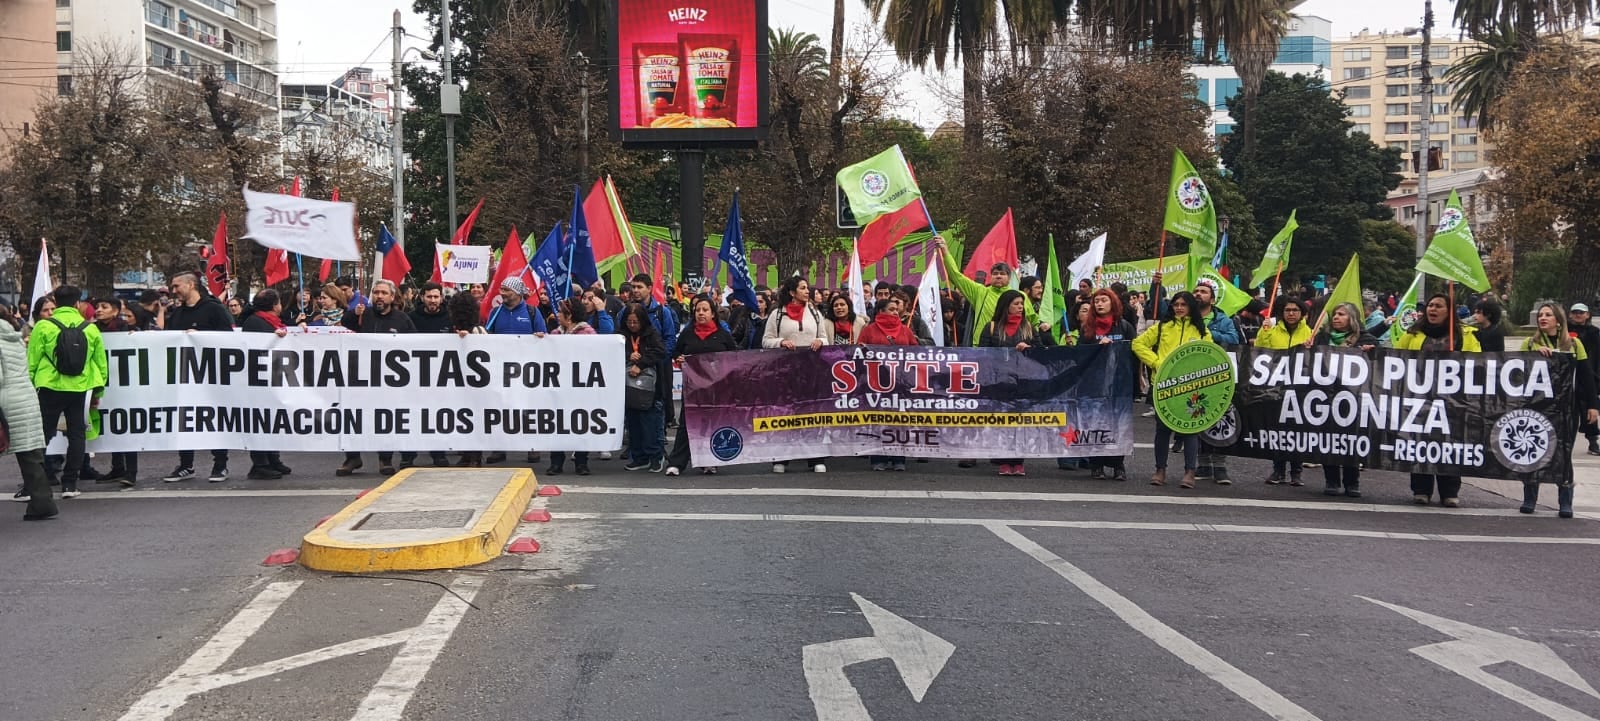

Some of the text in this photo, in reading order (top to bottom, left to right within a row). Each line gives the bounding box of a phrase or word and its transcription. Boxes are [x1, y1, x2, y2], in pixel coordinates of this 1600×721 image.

[667, 7, 708, 22] HEINZ
[650, 57, 674, 66] HEINZ
[699, 51, 725, 59] HEINZ
[453, 260, 479, 270] AJUNJI
[852, 347, 959, 362] Asociación
[1171, 346, 1213, 365] FEDEPRUS
[105, 346, 606, 388] TI IMPERIALISTAS POR LA
[831, 359, 981, 394] SUTE
[1178, 362, 1229, 384] SEGURIDAD
[1249, 352, 1369, 387] SALUD
[1382, 356, 1554, 398] PUBLICA
[1157, 372, 1230, 400] EN HOSPITALES
[835, 393, 979, 411] de Valparaíso
[1160, 385, 1231, 428] METROPOLITANA
[1279, 389, 1451, 435] AGONIZA
[99, 402, 616, 435] TODETERMINACIÓN DE LOS PUEBLOS.
[759, 413, 1060, 430] A CONSTRUIR UNA VERDADERA EDUCACIÓN PÚBLICA
[1496, 408, 1553, 432] CONFEDEPRUS
[881, 429, 940, 445] SUTE
